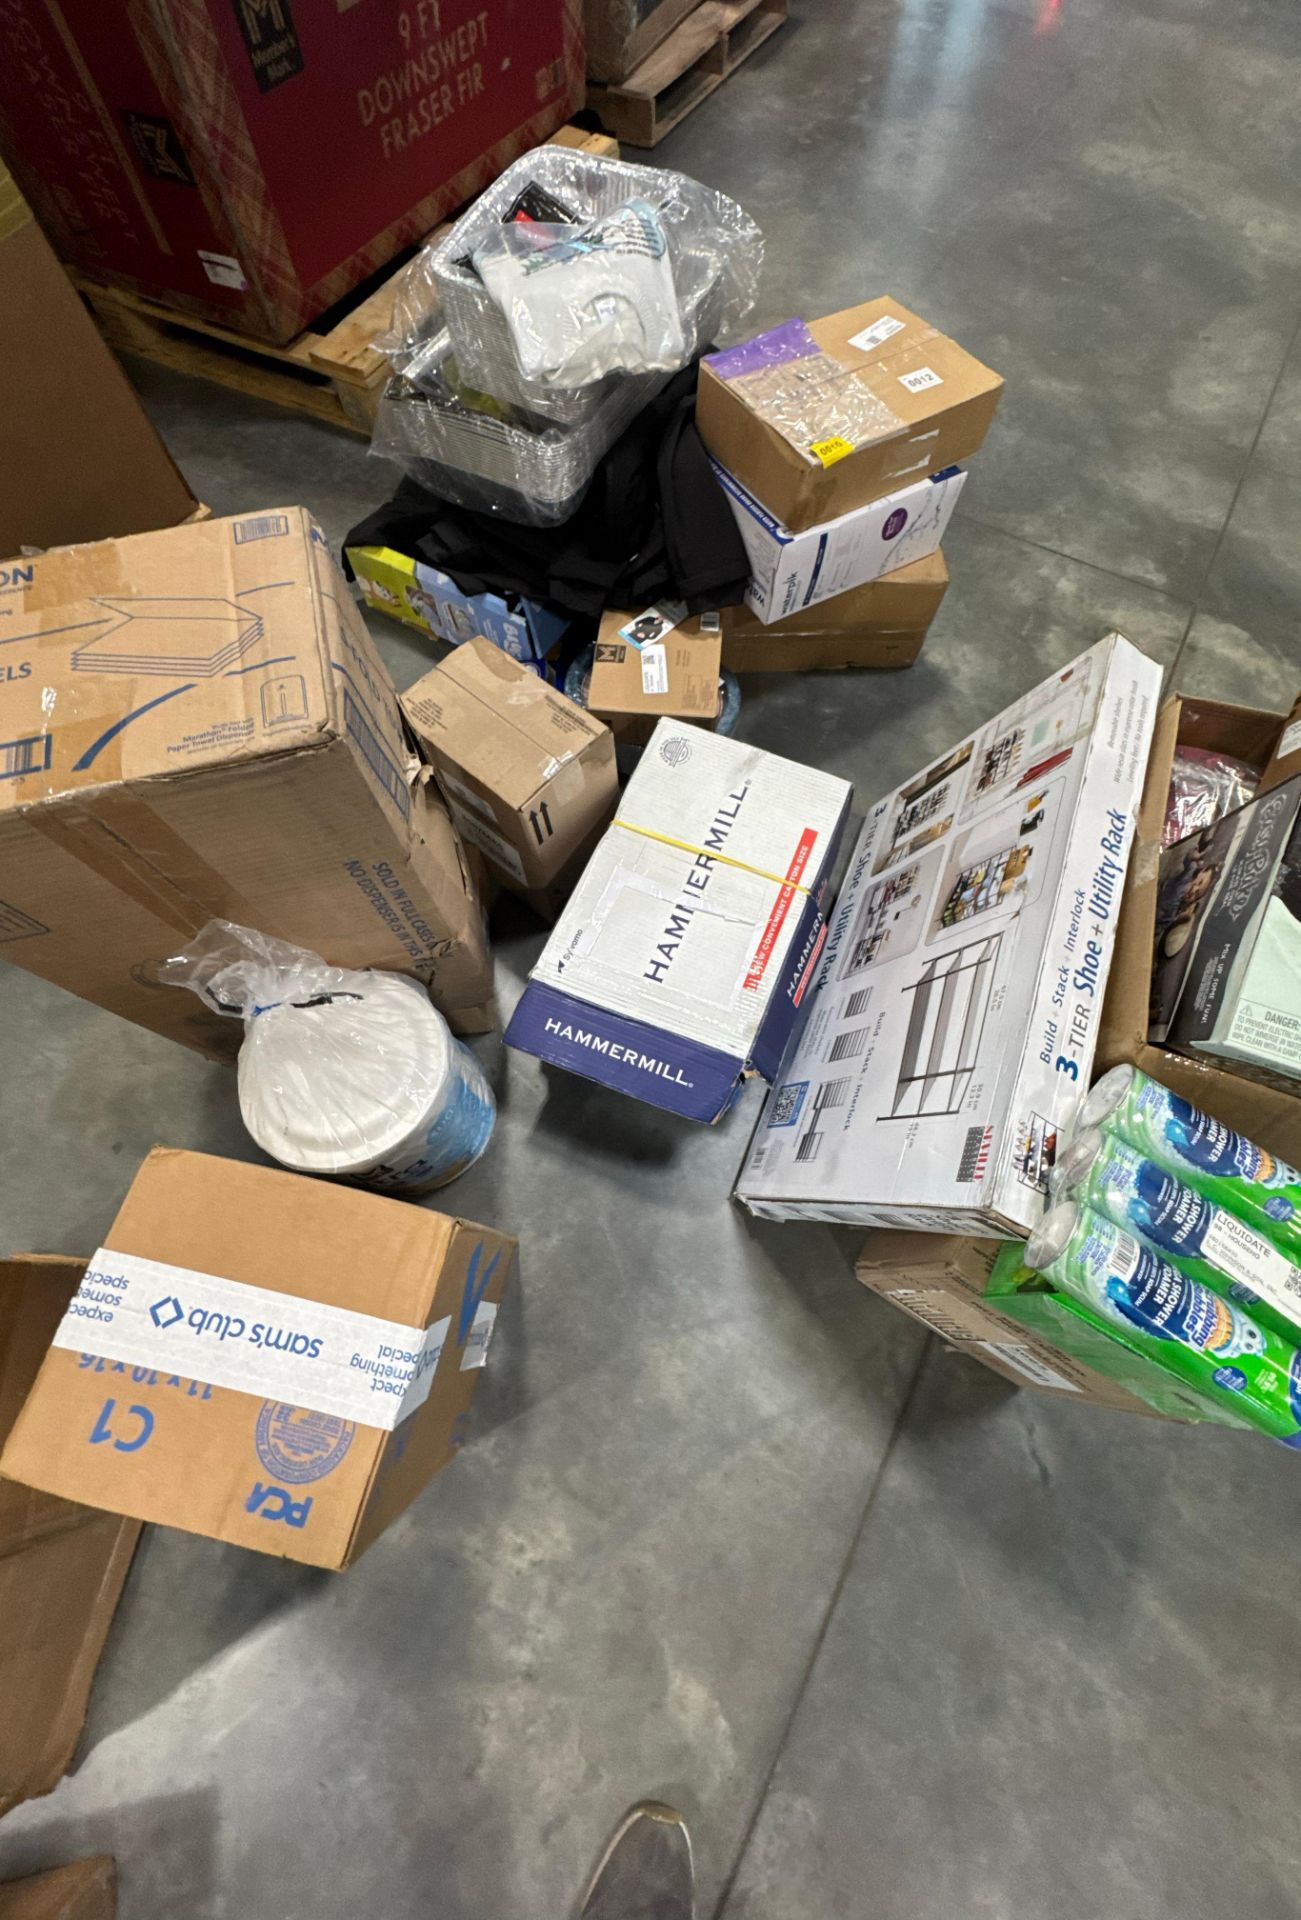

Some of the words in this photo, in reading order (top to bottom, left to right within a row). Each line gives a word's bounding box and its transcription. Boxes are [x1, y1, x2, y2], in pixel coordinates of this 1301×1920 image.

[416, 0, 441, 39] FT
[357, 10, 489, 127] DOWNSWEPT
[380, 84, 455, 159] FRASER
[457, 62, 486, 105] FIR
[907, 373, 934, 388] 0012
[166, 742, 190, 753] Paper
[192, 736, 215, 746] Towel
[228, 722, 254, 732] Folded
[1103, 808, 1128, 854] Rack
[344, 859, 365, 882] NO
[851, 849, 873, 889] Shoe
[1088, 855, 1123, 921] Utility
[372, 858, 400, 891] SOLD
[398, 897, 420, 923] FULL
[411, 916, 435, 944] CASES
[758, 897, 789, 950] CONVENIENT
[781, 863, 802, 898] CATON
[794, 844, 809, 864] SIZE
[826, 903, 853, 954] Utility
[814, 953, 833, 992] Rack
[1073, 942, 1104, 997] Shoe
[1215, 962, 1224, 974] UP
[1220, 942, 1230, 960] MIX
[1038, 1020, 1058, 1065] Build
[1051, 968, 1070, 1009] Stack
[1064, 888, 1087, 950] Interlock
[1207, 977, 1219, 1000] SOME
[872, 1011, 887, 1039] Build
[1056, 1005, 1092, 1081] 3-TIER
[545, 1017, 690, 1087] HAMMERMILL
[842, 1083, 864, 1131] Interlock
[971, 1125, 994, 1182] SEVILLE
[1171, 1203, 1202, 1246] SHOWER
[1216, 1214, 1272, 1258] LIQUIDATE
[1153, 1264, 1174, 1306] FOAMER
[1153, 1284, 1182, 1327] SHOWER
[188, 1305, 245, 1337] club
[1181, 1286, 1213, 1333] ubbles
[249, 1319, 323, 1360] sam's
[378, 1343, 421, 1367] pecial
[350, 1351, 417, 1382] omething
[370, 1378, 407, 1399] xpect
[89, 1398, 156, 1453] C1
[245, 1481, 313, 1529] PCA
